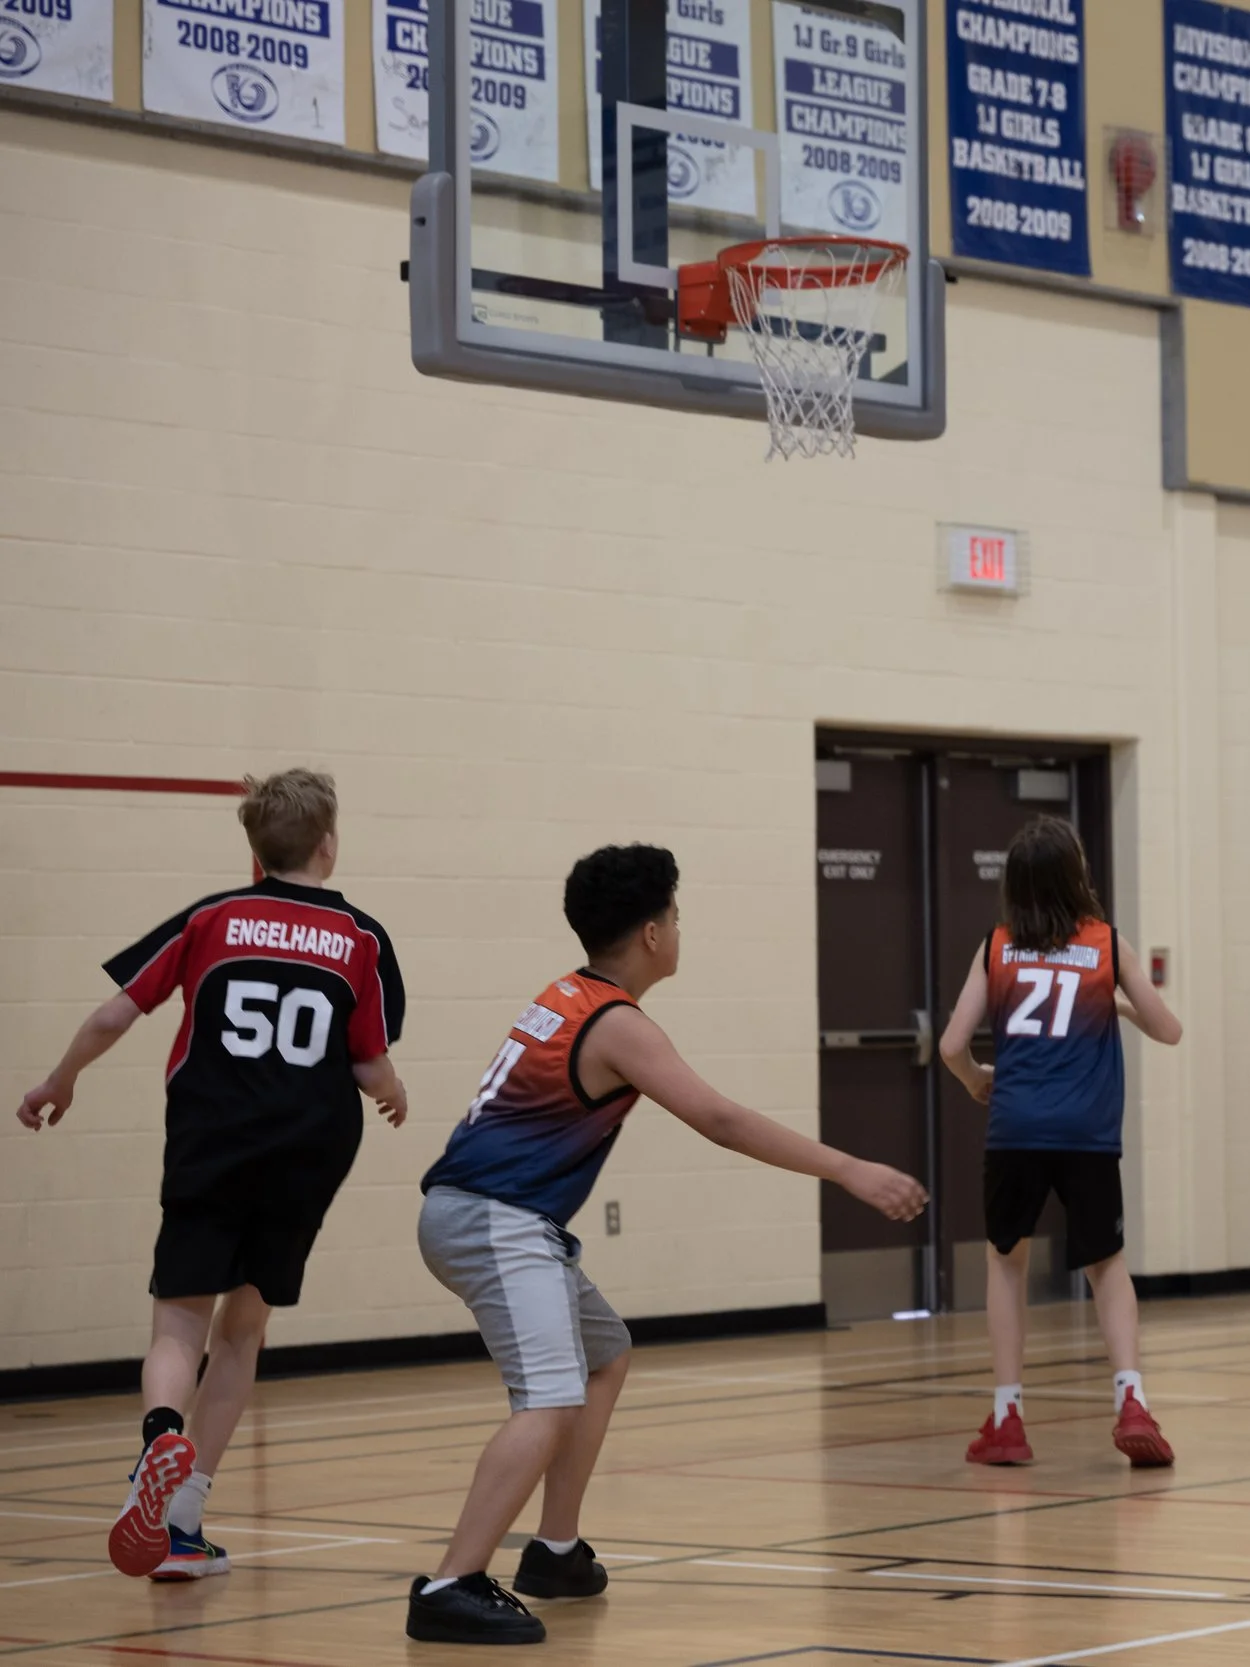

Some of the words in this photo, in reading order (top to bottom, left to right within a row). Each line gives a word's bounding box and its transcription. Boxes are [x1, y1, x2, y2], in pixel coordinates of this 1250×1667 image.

[166, 0, 321, 32] MPIONS
[677, 0, 724, 25] Girls
[178, 20, 308, 69] 2008-2009
[864, 37, 906, 68] Girls
[957, 10, 1079, 63] CHAMPIONS
[812, 68, 892, 108] LEAGUE
[968, 63, 1033, 105] GRADE
[1035, 78, 1067, 112] 7-8
[977, 104, 996, 134] 1J
[1001, 108, 1060, 148] GIRLS
[1182, 113, 1243, 151] GRADE
[952, 138, 1085, 190] BASKETBALL
[967, 196, 1071, 241] 2008-2009
[823, 865, 846, 880] EXIT
[849, 866, 876, 880] ONLY
[226, 918, 355, 965] ENGELHARDT
[221, 979, 333, 1068] 50
[1006, 968, 1080, 1037] 21
